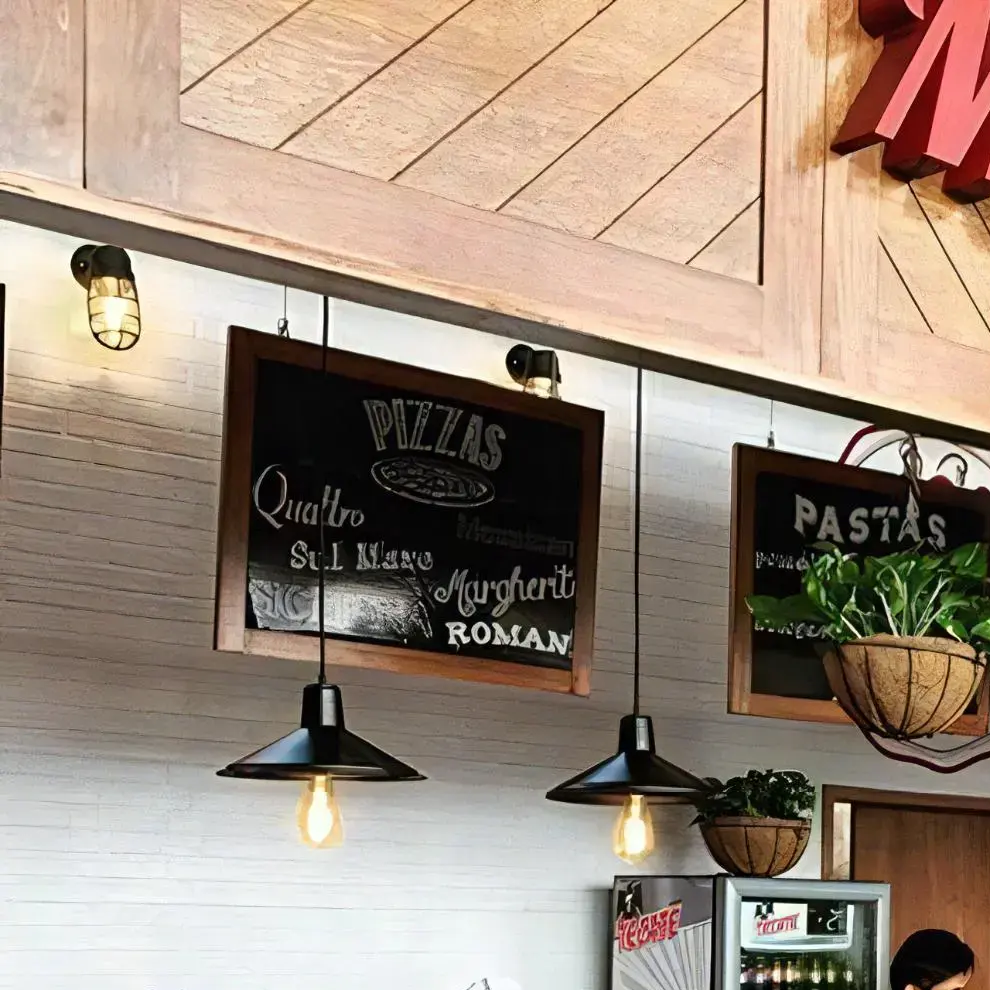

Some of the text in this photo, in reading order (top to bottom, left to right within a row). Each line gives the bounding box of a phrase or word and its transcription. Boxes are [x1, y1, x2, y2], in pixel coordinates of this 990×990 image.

[363, 397, 508, 472] PIZZAS
[253, 463, 366, 529] Quattro
[794, 493, 948, 552] PASTAS
[434, 564, 576, 618] Margherit
[445, 620, 573, 659] ROMAN
